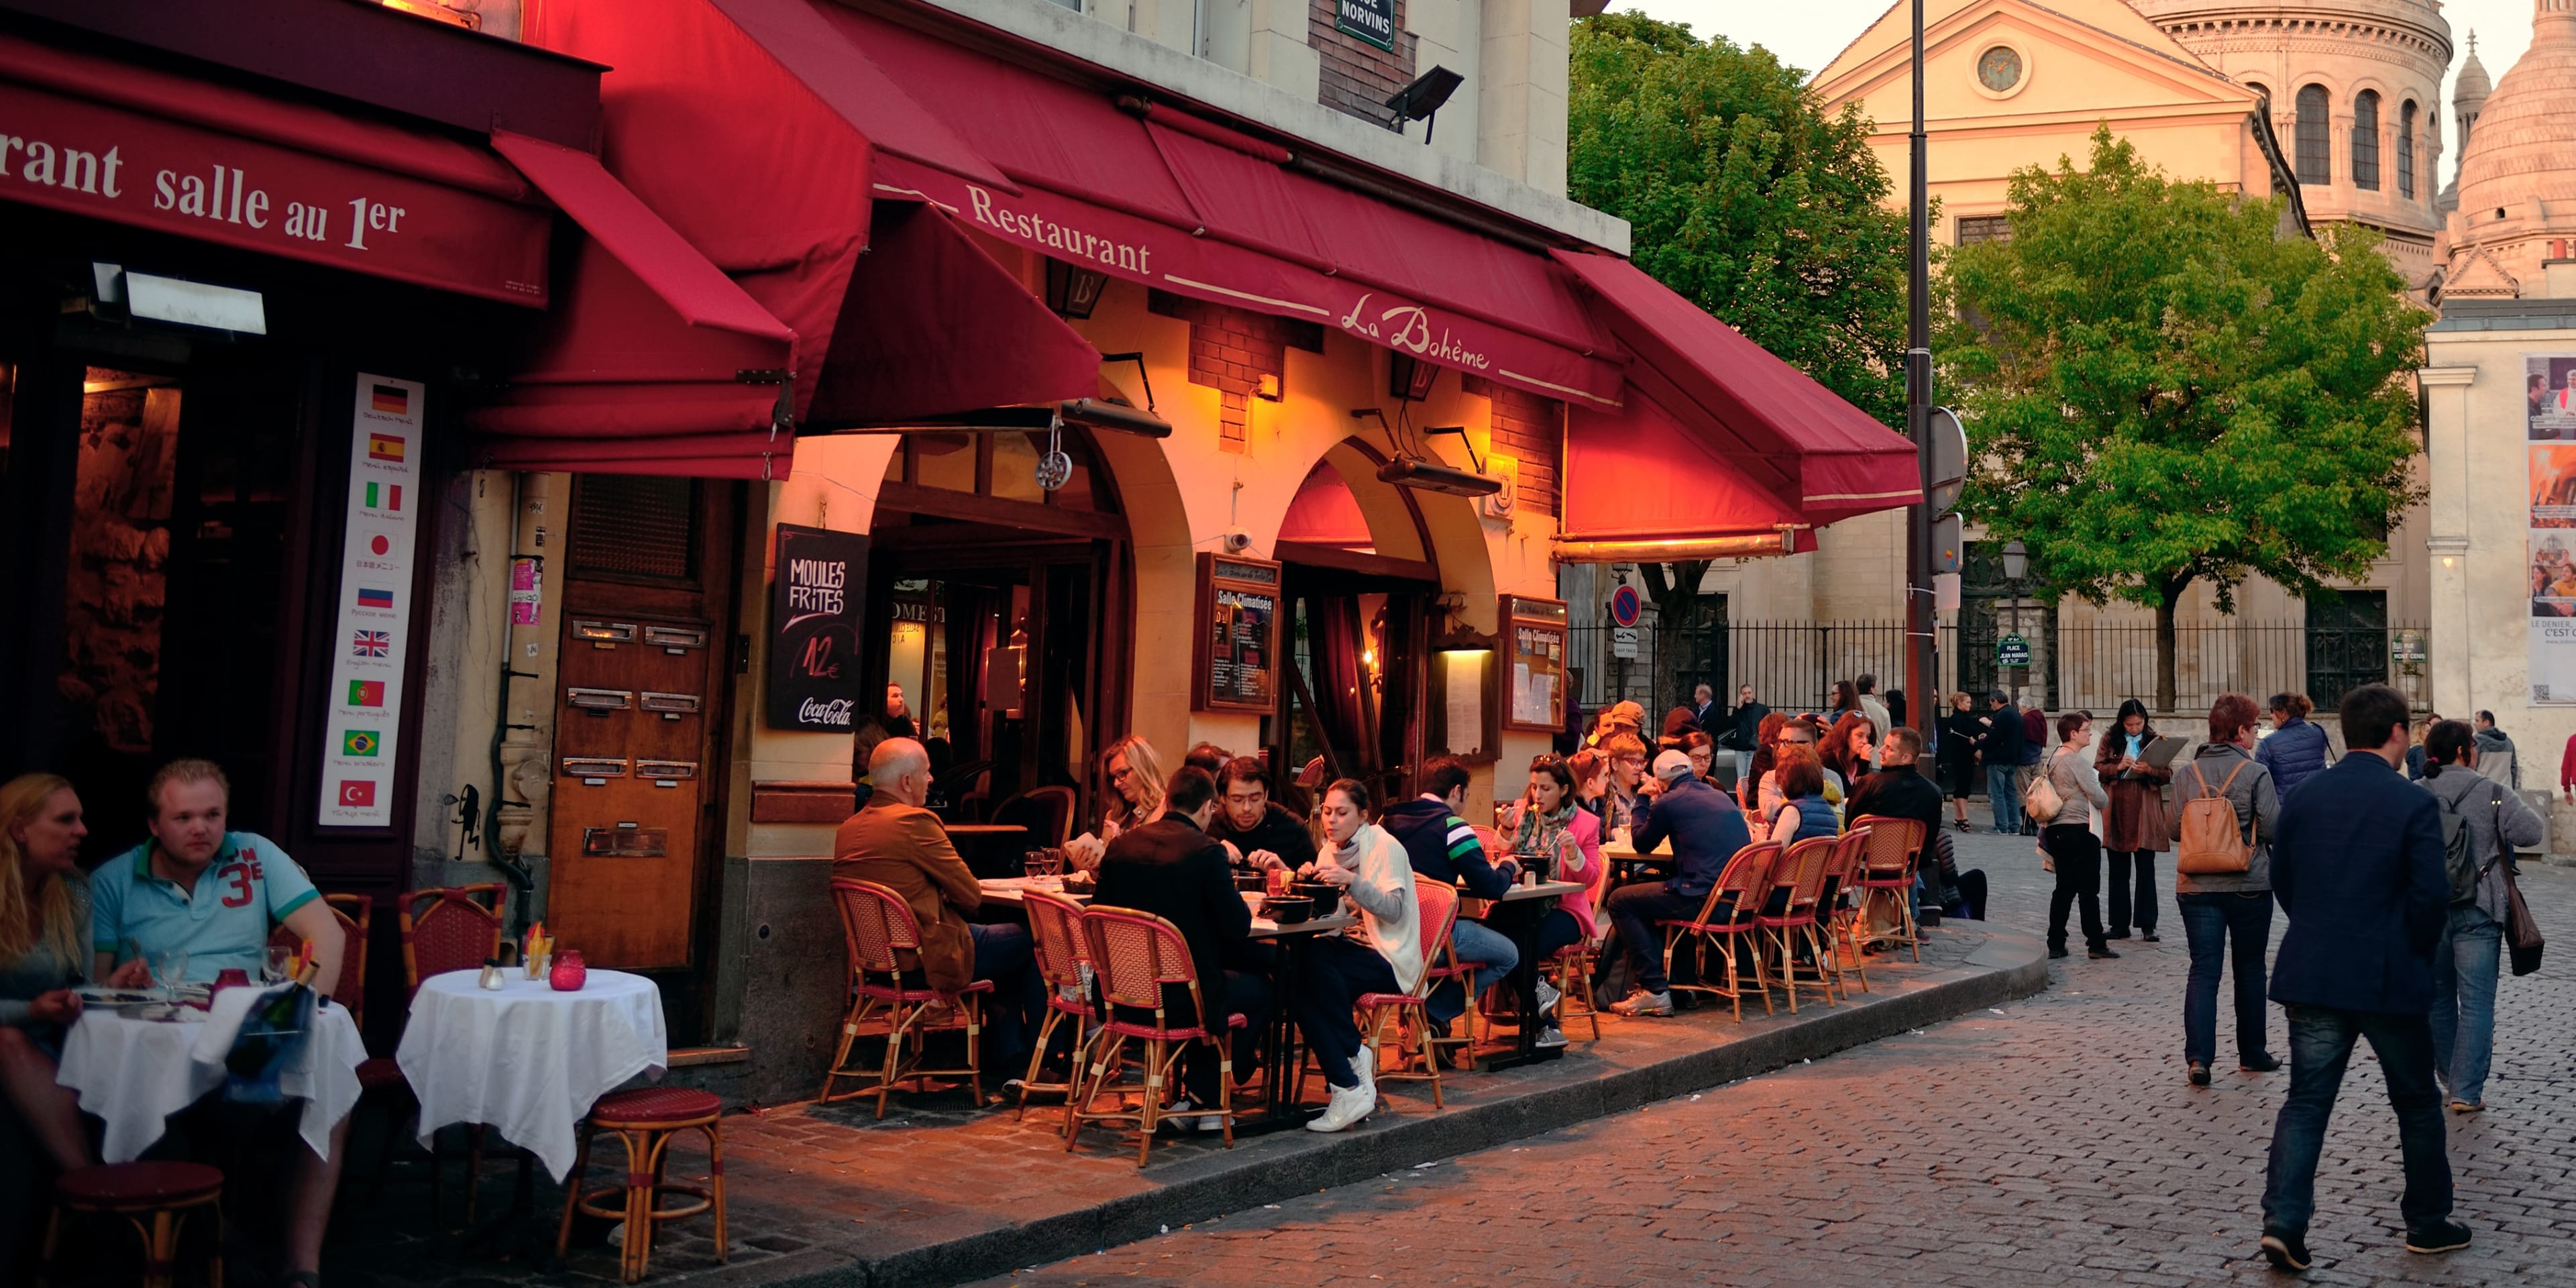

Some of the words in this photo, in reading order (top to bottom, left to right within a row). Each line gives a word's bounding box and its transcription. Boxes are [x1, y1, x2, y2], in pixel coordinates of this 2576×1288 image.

[1342, 0, 1390, 34] NORVINS
[0, 135, 123, 198] rant
[154, 164, 269, 228] salle
[285, 201, 327, 241] au
[344, 197, 406, 250] 1er
[965, 184, 1151, 276] Restaurant
[1342, 293, 1380, 339] La
[1382, 305, 1490, 370] Bohème
[790, 559, 846, 589] MOULES
[1218, 590, 1236, 605] Salle
[1237, 592, 1272, 610] Climatisée
[1518, 627, 1532, 641] Salle
[1533, 629, 1560, 644] Climatisée
[2542, 621, 2573, 629] DENIER,
[2545, 629, 2570, 637] C'EST
[798, 696, 855, 726] Coca-Cola
[217, 863, 252, 908] 3
